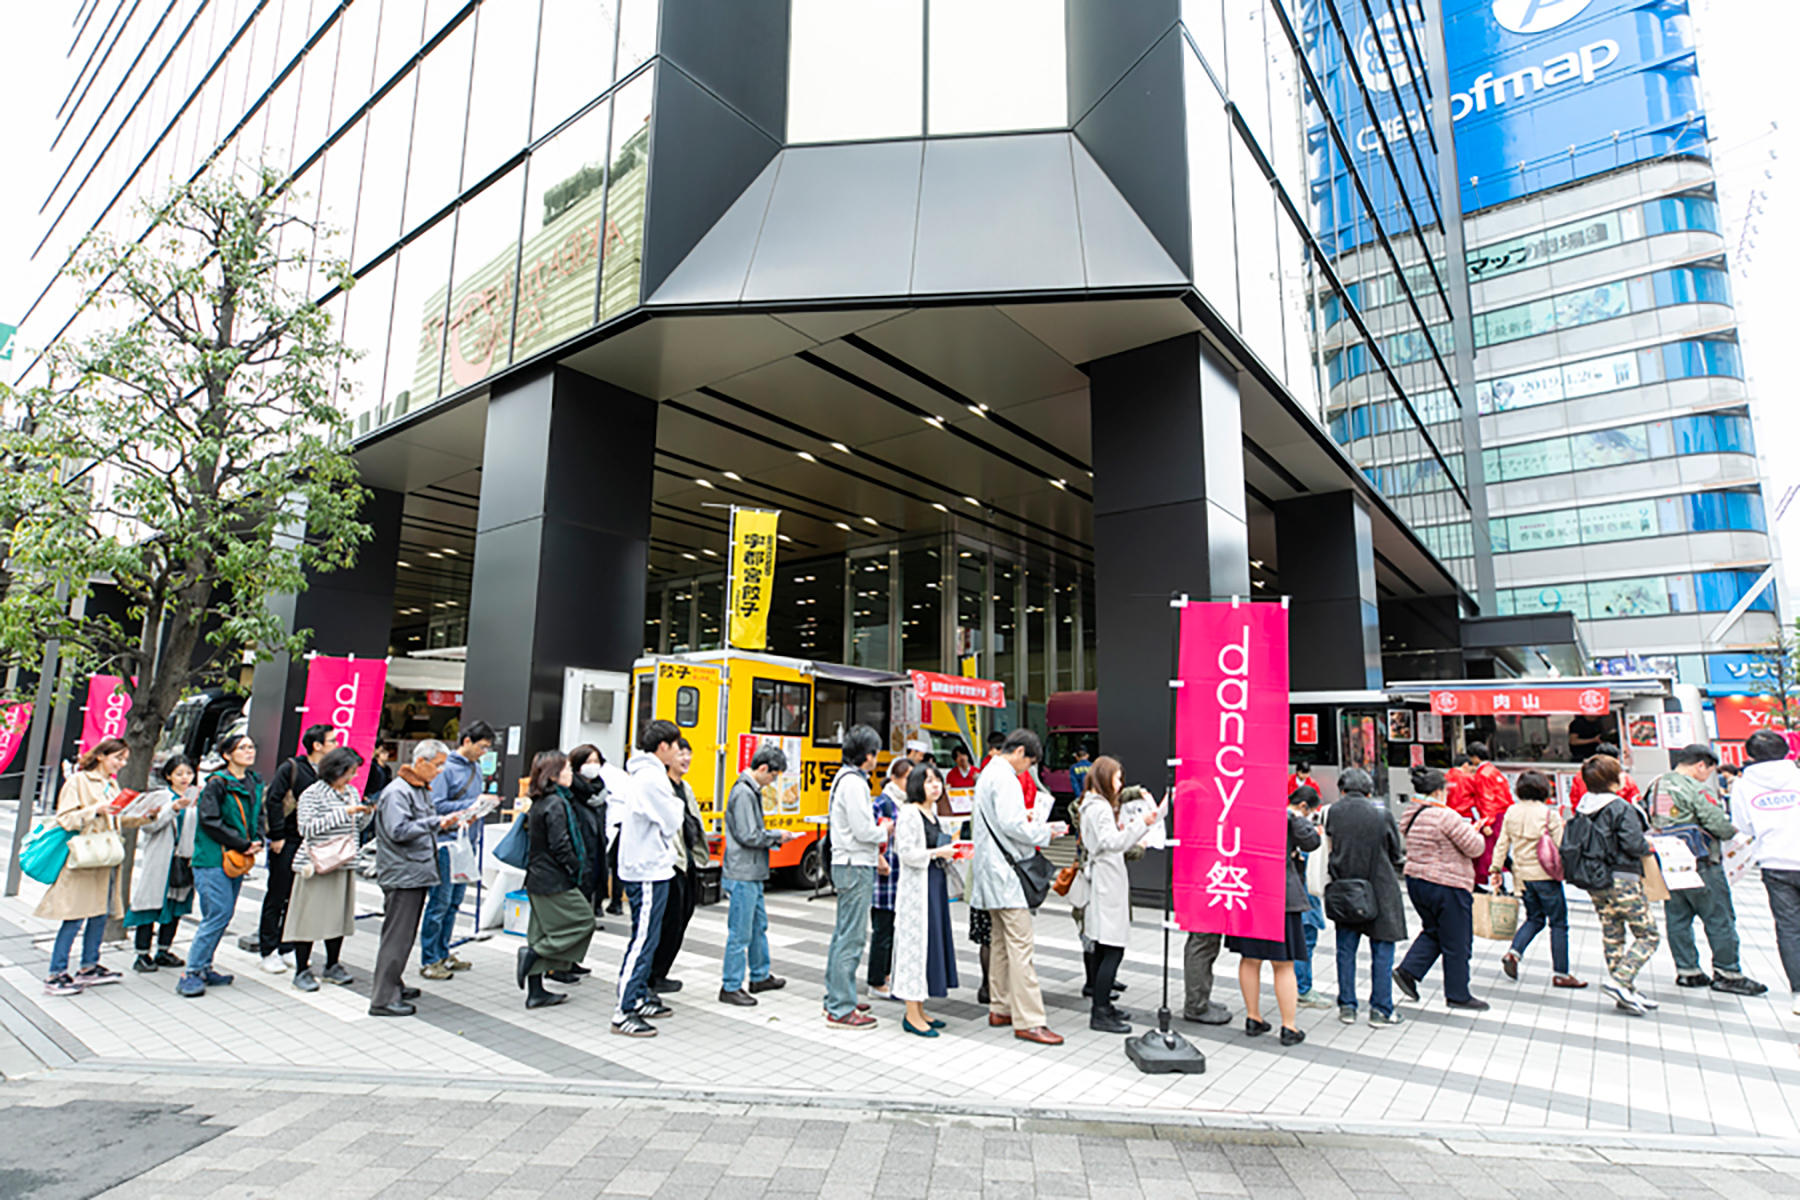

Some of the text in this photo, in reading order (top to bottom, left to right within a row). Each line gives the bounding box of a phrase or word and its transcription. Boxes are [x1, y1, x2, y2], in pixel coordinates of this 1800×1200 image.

[740, 533, 765, 618] 宇都宮餃子
